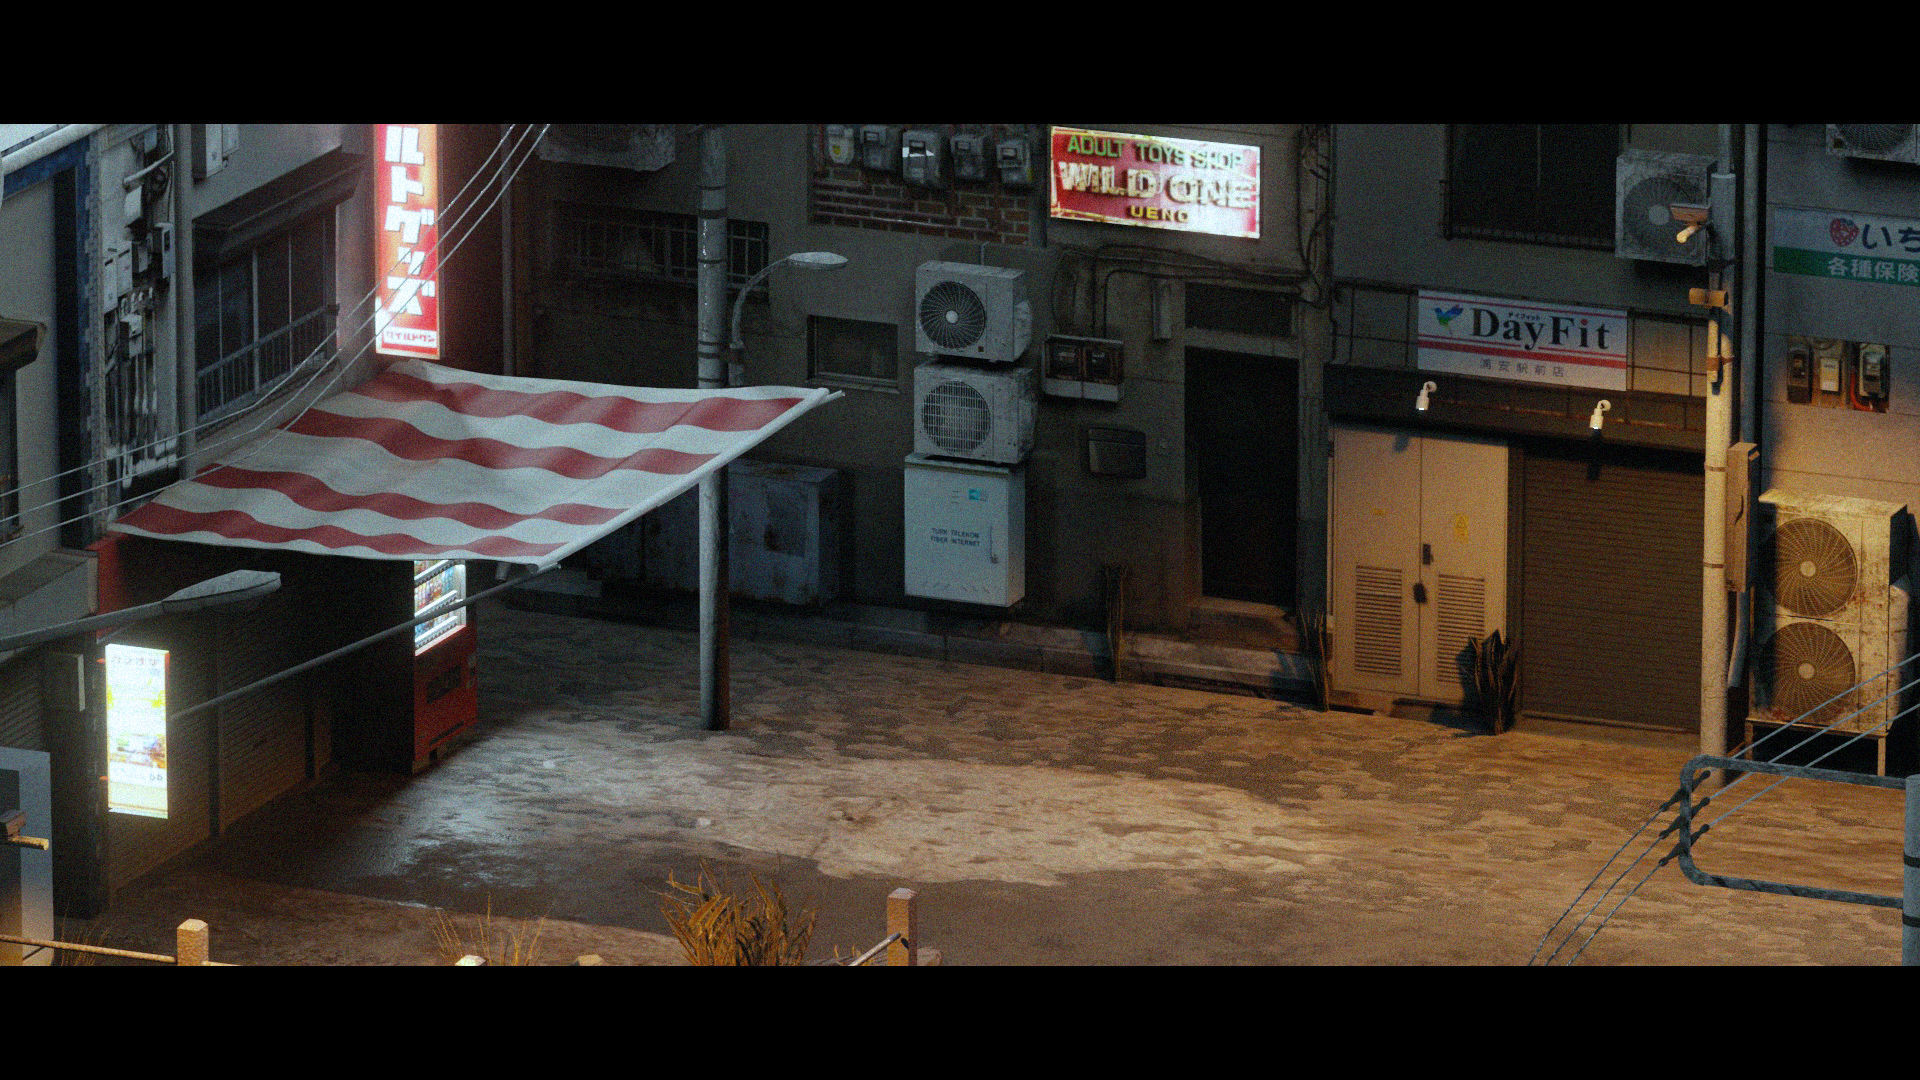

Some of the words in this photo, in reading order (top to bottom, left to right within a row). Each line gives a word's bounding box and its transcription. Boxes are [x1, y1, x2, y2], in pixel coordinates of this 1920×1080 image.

[1067, 135, 1125, 158] ADULT
[1134, 142, 1186, 166] TOYS
[1191, 149, 1244, 169] SHOP
[1058, 161, 1159, 198] WILD
[1167, 174, 1257, 209] ONE
[1129, 205, 1189, 223] UENO
[1828, 257, 1920, 283] 各種保険
[1470, 307, 1610, 350] DayFit
